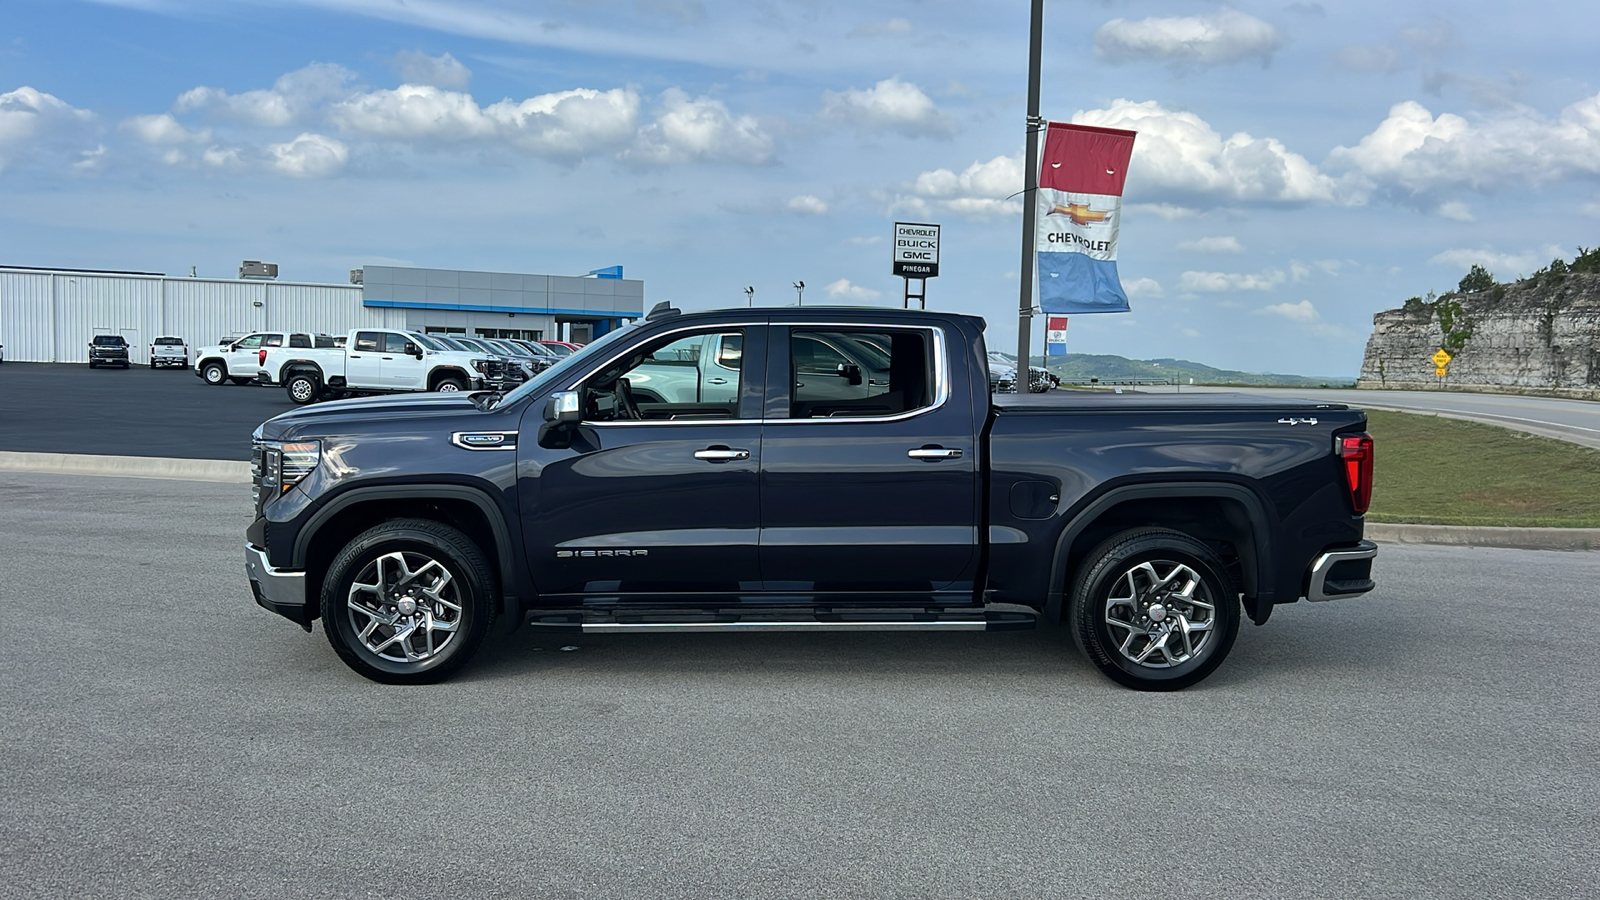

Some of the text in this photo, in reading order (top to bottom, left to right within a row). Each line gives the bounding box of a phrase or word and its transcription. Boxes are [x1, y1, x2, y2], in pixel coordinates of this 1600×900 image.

[898, 228, 937, 237] CHEVROLET
[897, 239, 937, 249] BUICK
[1047, 232, 1111, 252] CHEVROLET
[902, 251, 931, 260] GMC
[902, 265, 931, 273] PINEGAR
[556, 549, 649, 558] SIERRA
